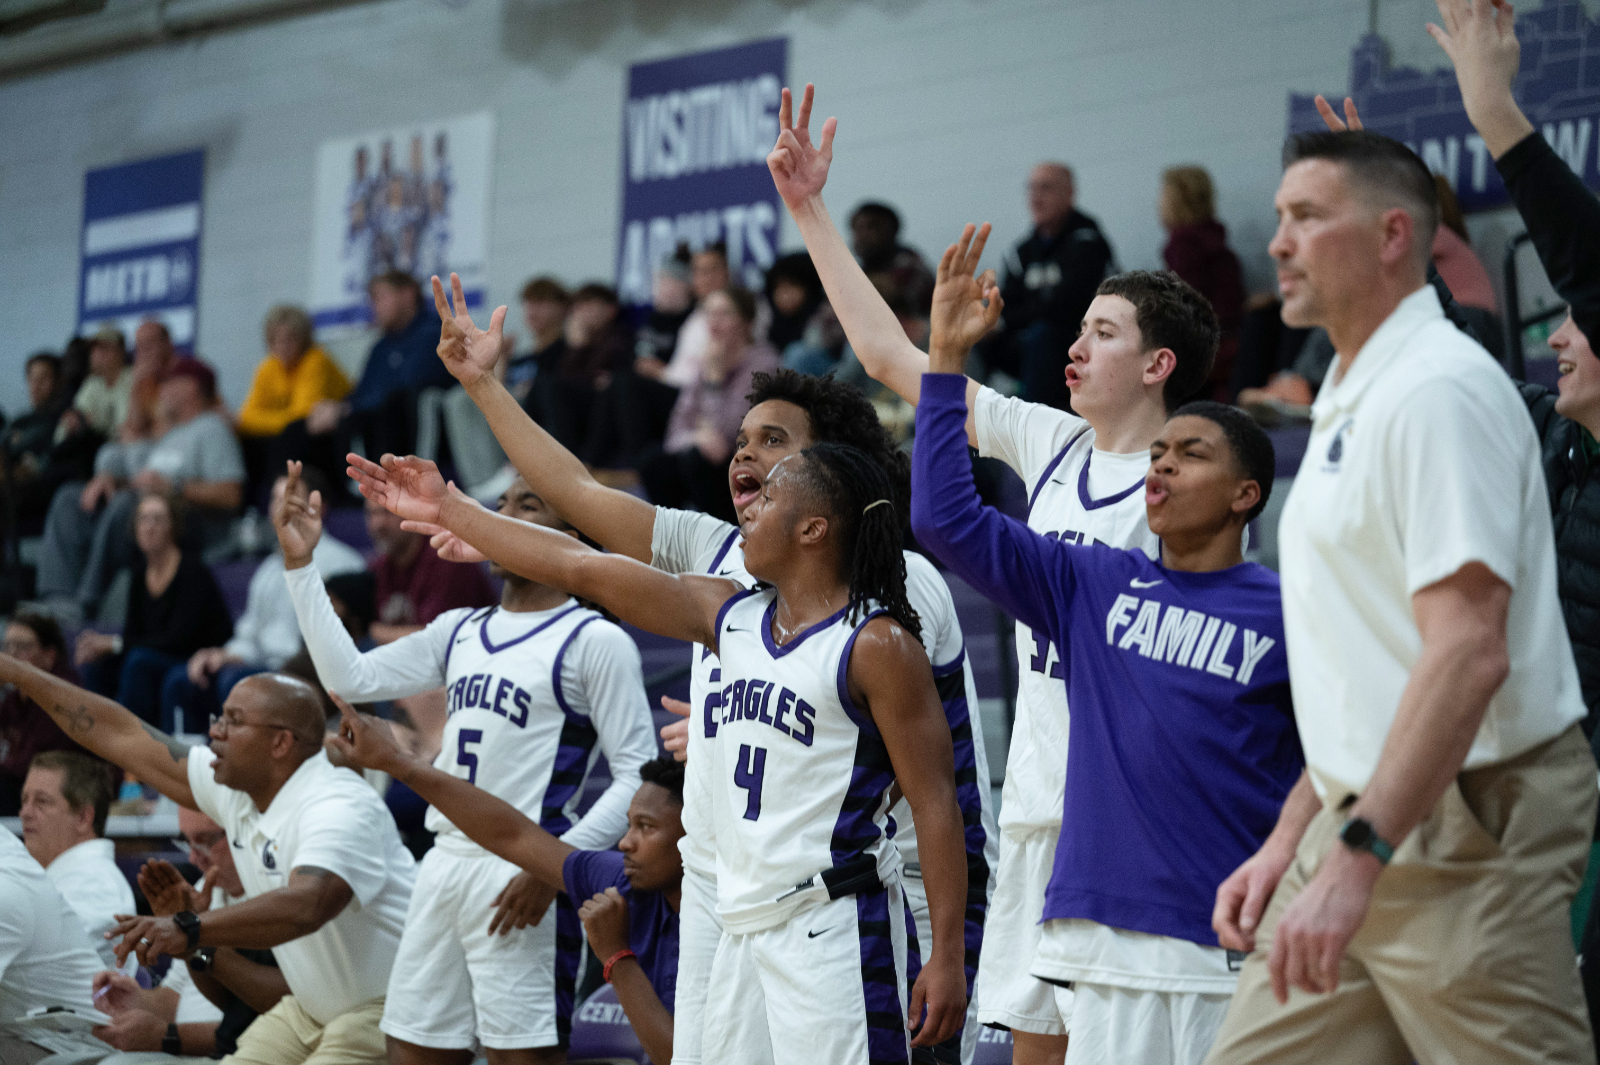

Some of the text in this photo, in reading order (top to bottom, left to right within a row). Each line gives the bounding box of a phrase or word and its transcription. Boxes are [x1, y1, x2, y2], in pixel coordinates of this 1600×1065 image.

[627, 74, 780, 183] VISITING
[1106, 592, 1276, 686] FAMILY
[447, 673, 532, 729] EAGLES
[721, 678, 816, 747] EAGLES
[457, 728, 483, 787] 5
[734, 743, 767, 822] 4
